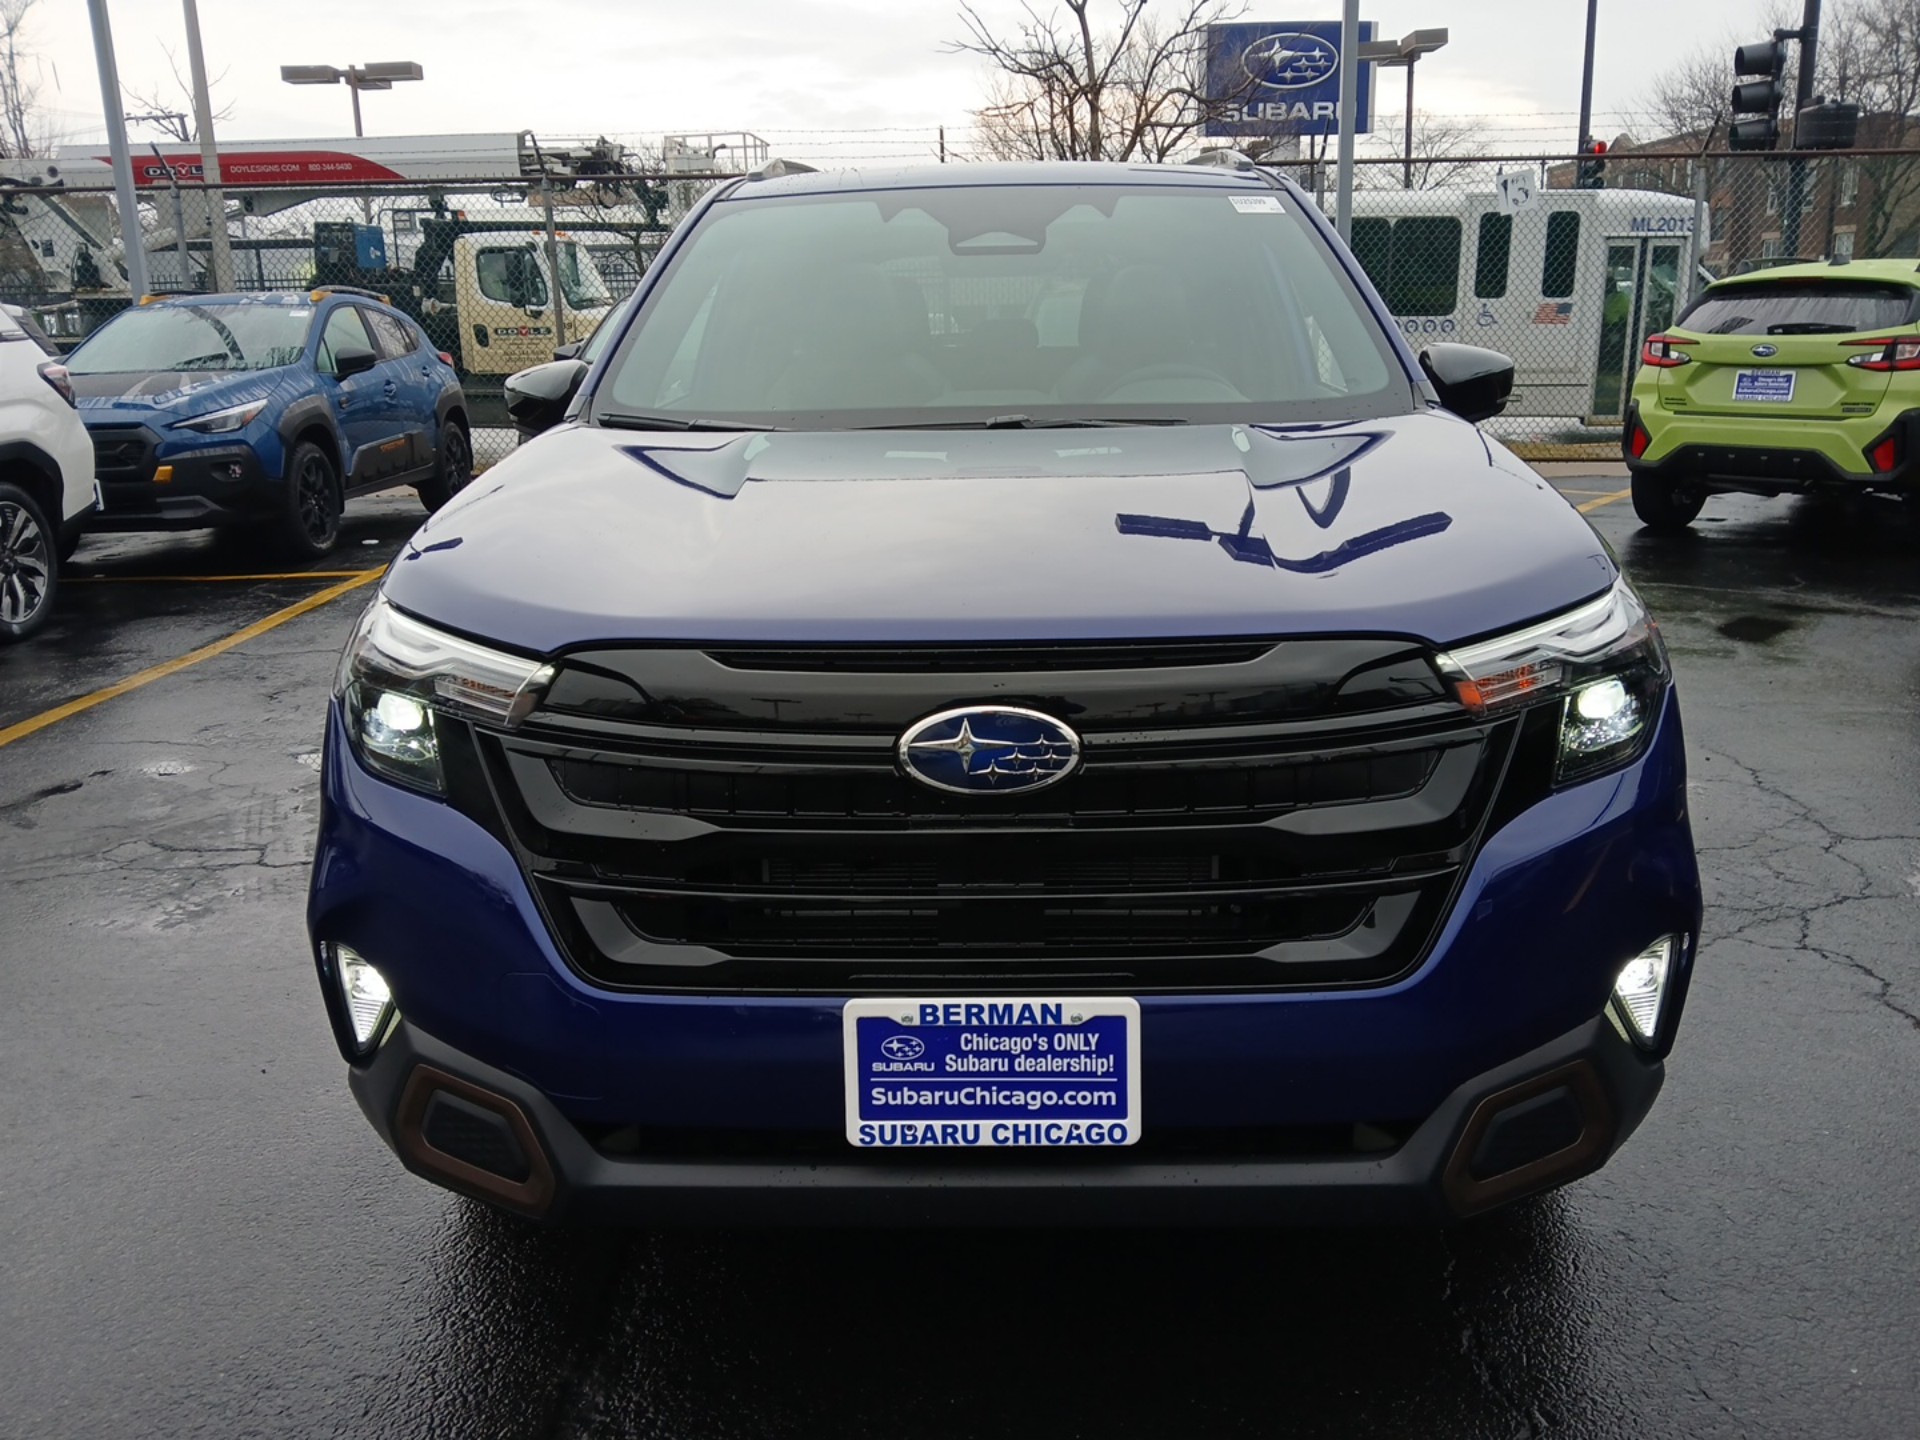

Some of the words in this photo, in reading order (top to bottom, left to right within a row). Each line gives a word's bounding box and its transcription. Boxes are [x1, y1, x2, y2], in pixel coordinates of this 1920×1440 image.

[148, 166, 203, 176] DOYL
[1631, 216, 1696, 232] ML2013
[496, 326, 549, 336] DOYLE
[918, 1003, 1063, 1026] BERMAN
[960, 1033, 1048, 1053] Chicago's
[1053, 1033, 1100, 1051] ONLY
[871, 1062, 935, 1072] SUBARU
[945, 1054, 1009, 1072] Subaru
[1014, 1054, 1115, 1076] dealership!
[870, 1086, 1117, 1110] SubaruChicago.com
[858, 1123, 987, 1145] SUBARU
[991, 1123, 1128, 1146] CHICAGO
